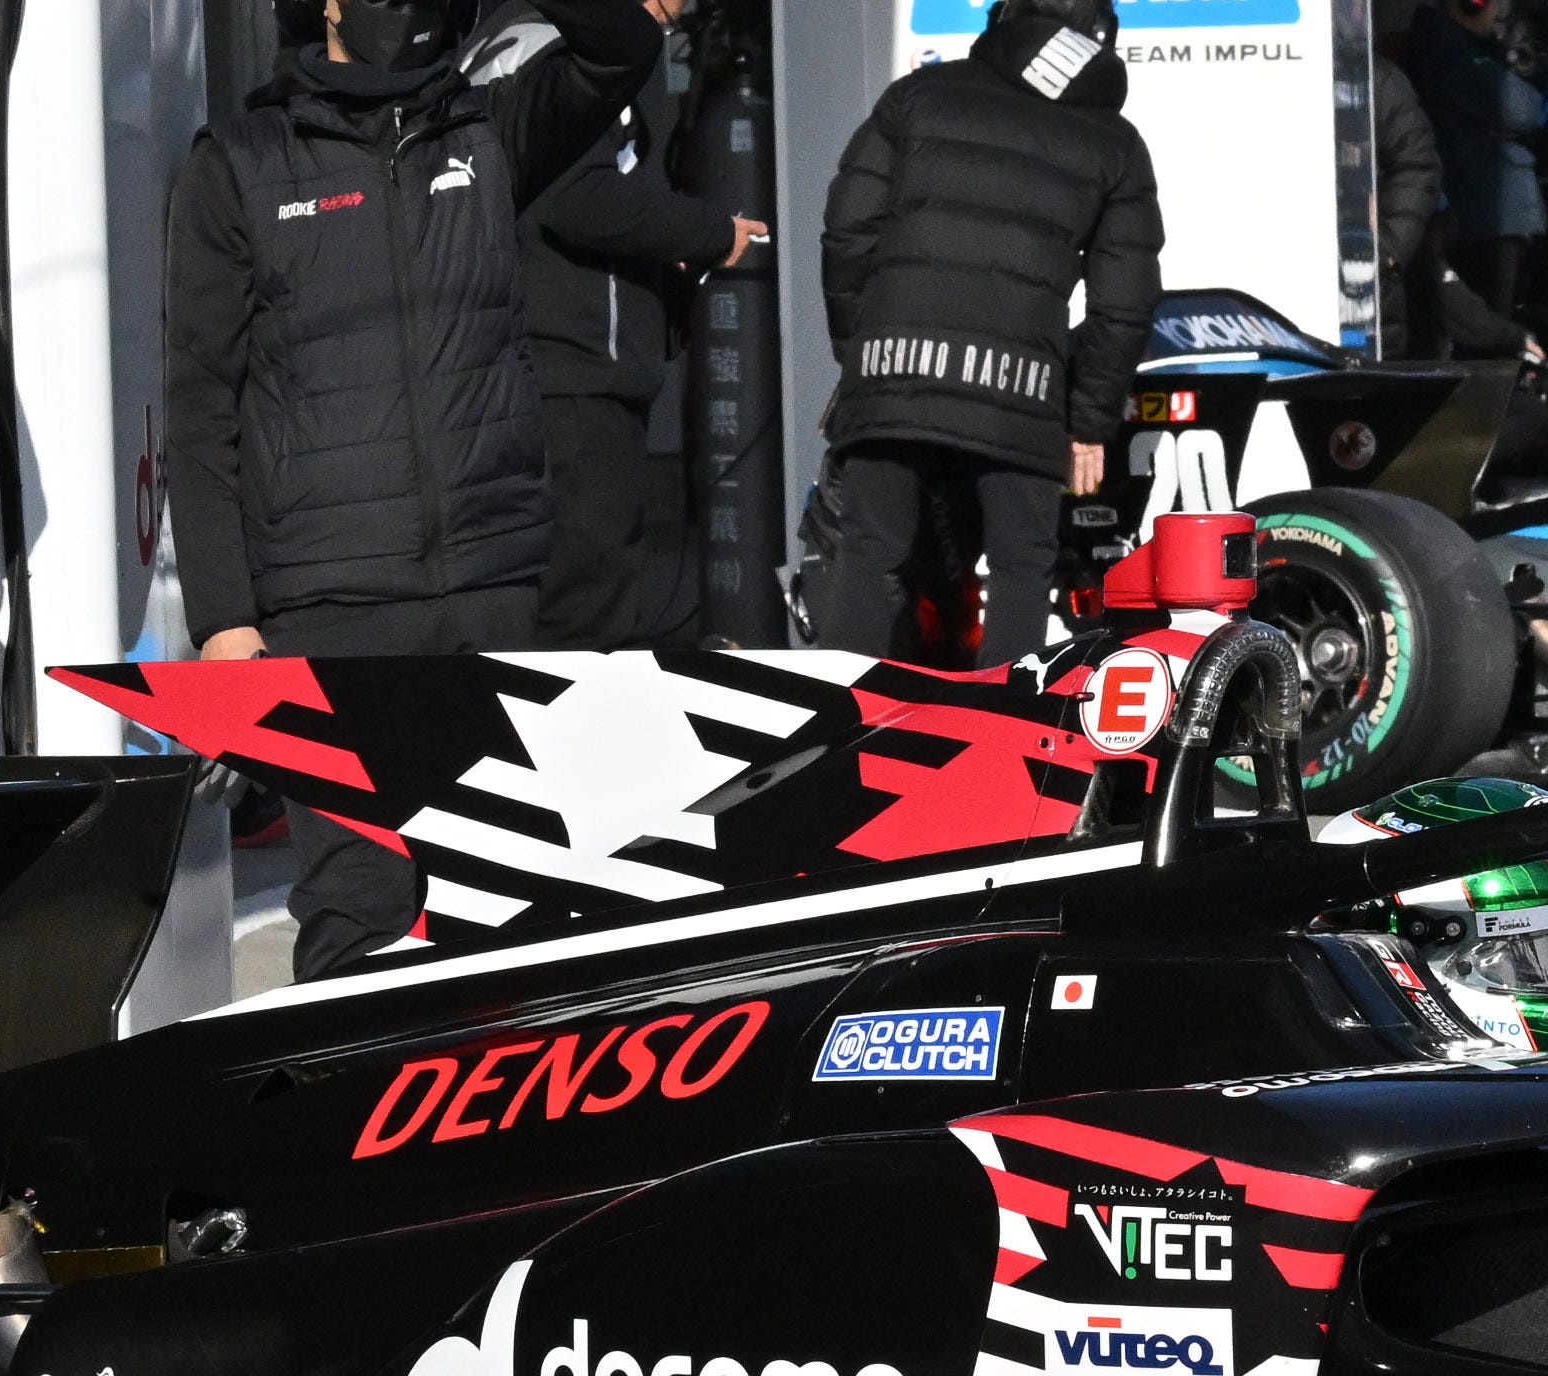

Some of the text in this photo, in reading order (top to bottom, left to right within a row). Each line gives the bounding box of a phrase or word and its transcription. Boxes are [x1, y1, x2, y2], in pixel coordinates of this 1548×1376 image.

[1114, 43, 1303, 64] EAM IMPUL
[278, 199, 317, 220] ROOKIE
[862, 340, 1052, 402] HOSHINO RACING
[1269, 527, 1343, 557] YOKOHAMA
[1367, 610, 1399, 725] ADVAN
[1097, 666, 1155, 733] E
[866, 1016, 990, 1045] OGURA
[1475, 1014, 1521, 1037] INTO
[861, 1044, 989, 1072] CLUTCH
[351, 1001, 772, 1160] DENSO
[1077, 1183, 1233, 1202] いつもさいしょ、アタラシイコト。
[1168, 1210, 1232, 1222] Creative Power
